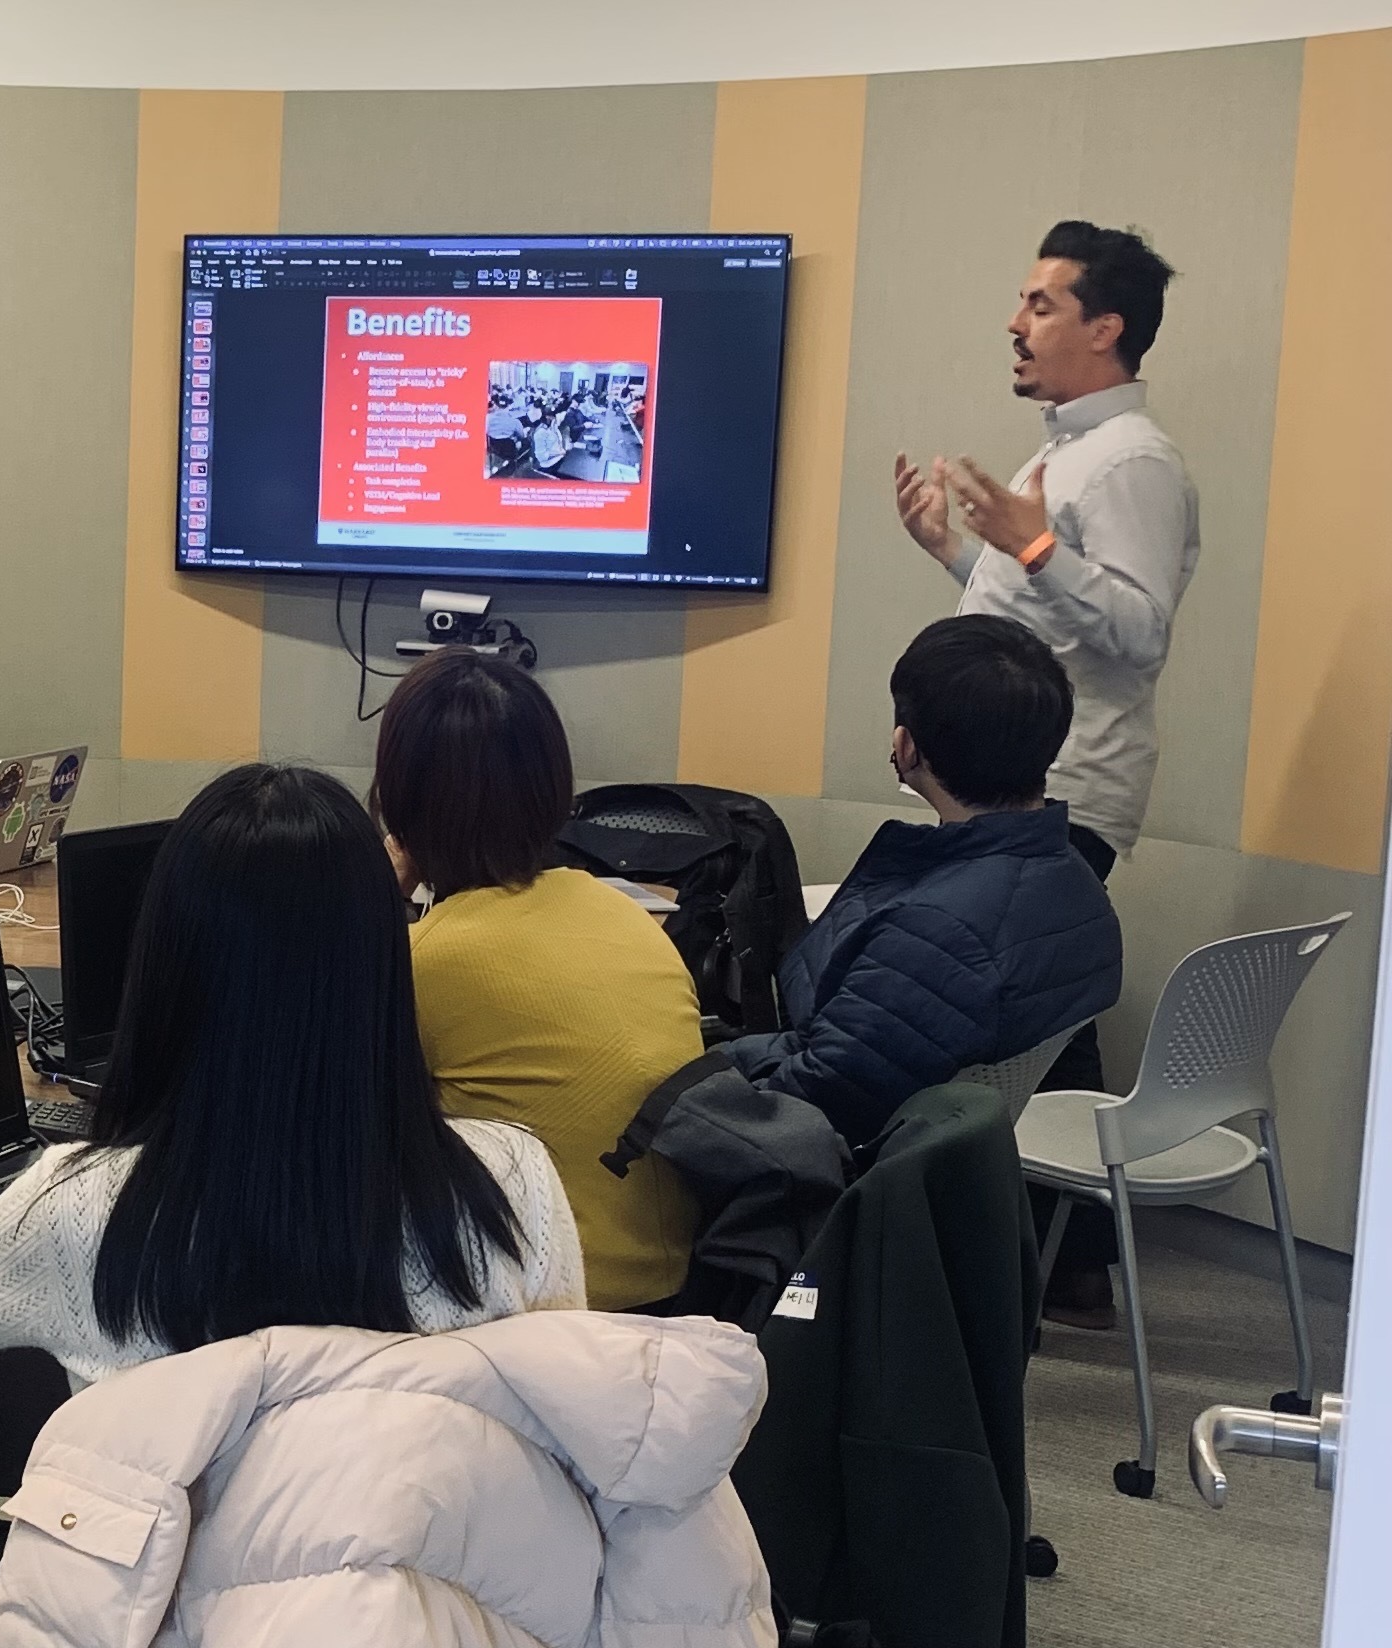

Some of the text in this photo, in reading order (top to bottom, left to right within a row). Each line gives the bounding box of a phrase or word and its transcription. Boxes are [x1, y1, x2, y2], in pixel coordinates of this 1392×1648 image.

[347, 306, 471, 337] Benefits
[357, 351, 405, 361] Affordances
[395, 463, 428, 473] Benefits
[52, 772, 76, 786] NASA
